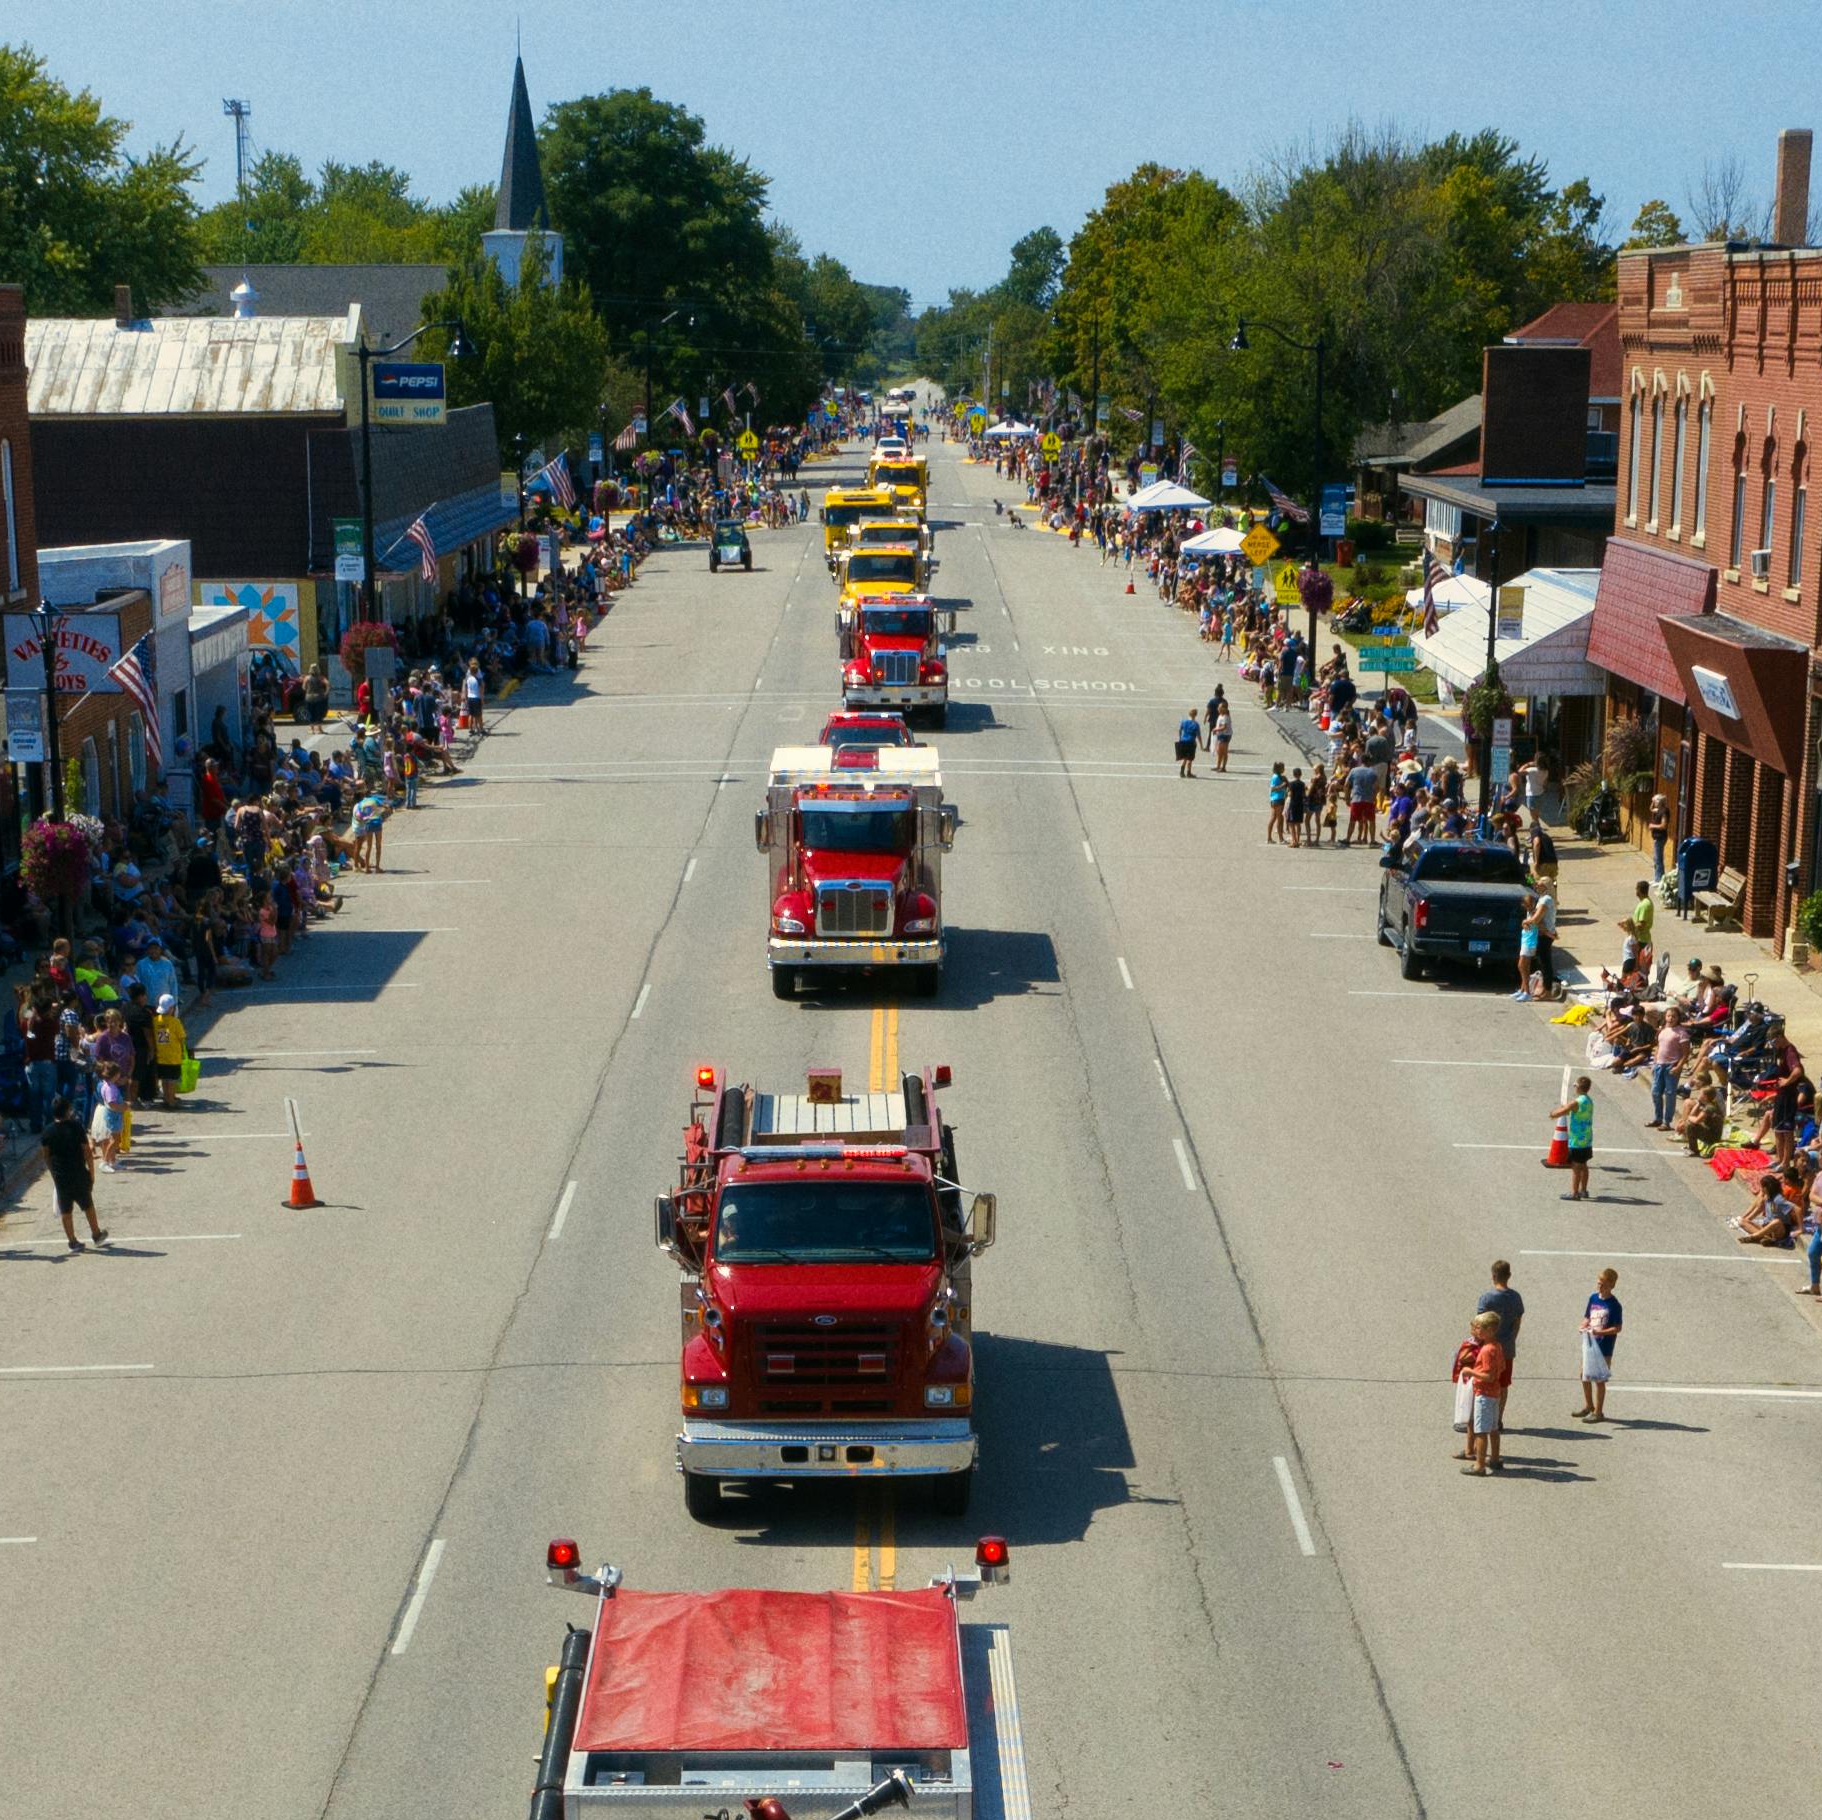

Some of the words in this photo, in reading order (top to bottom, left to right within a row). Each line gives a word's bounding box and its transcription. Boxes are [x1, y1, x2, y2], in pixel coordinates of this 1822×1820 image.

[399, 376, 438, 387] PEPSI
[413, 405, 440, 418] SHOP
[13, 631, 112, 663] VAETIES
[1042, 646, 1110, 656] XING
[54, 674, 86, 690] OYS
[1033, 679, 1148, 692] SCHOOL
